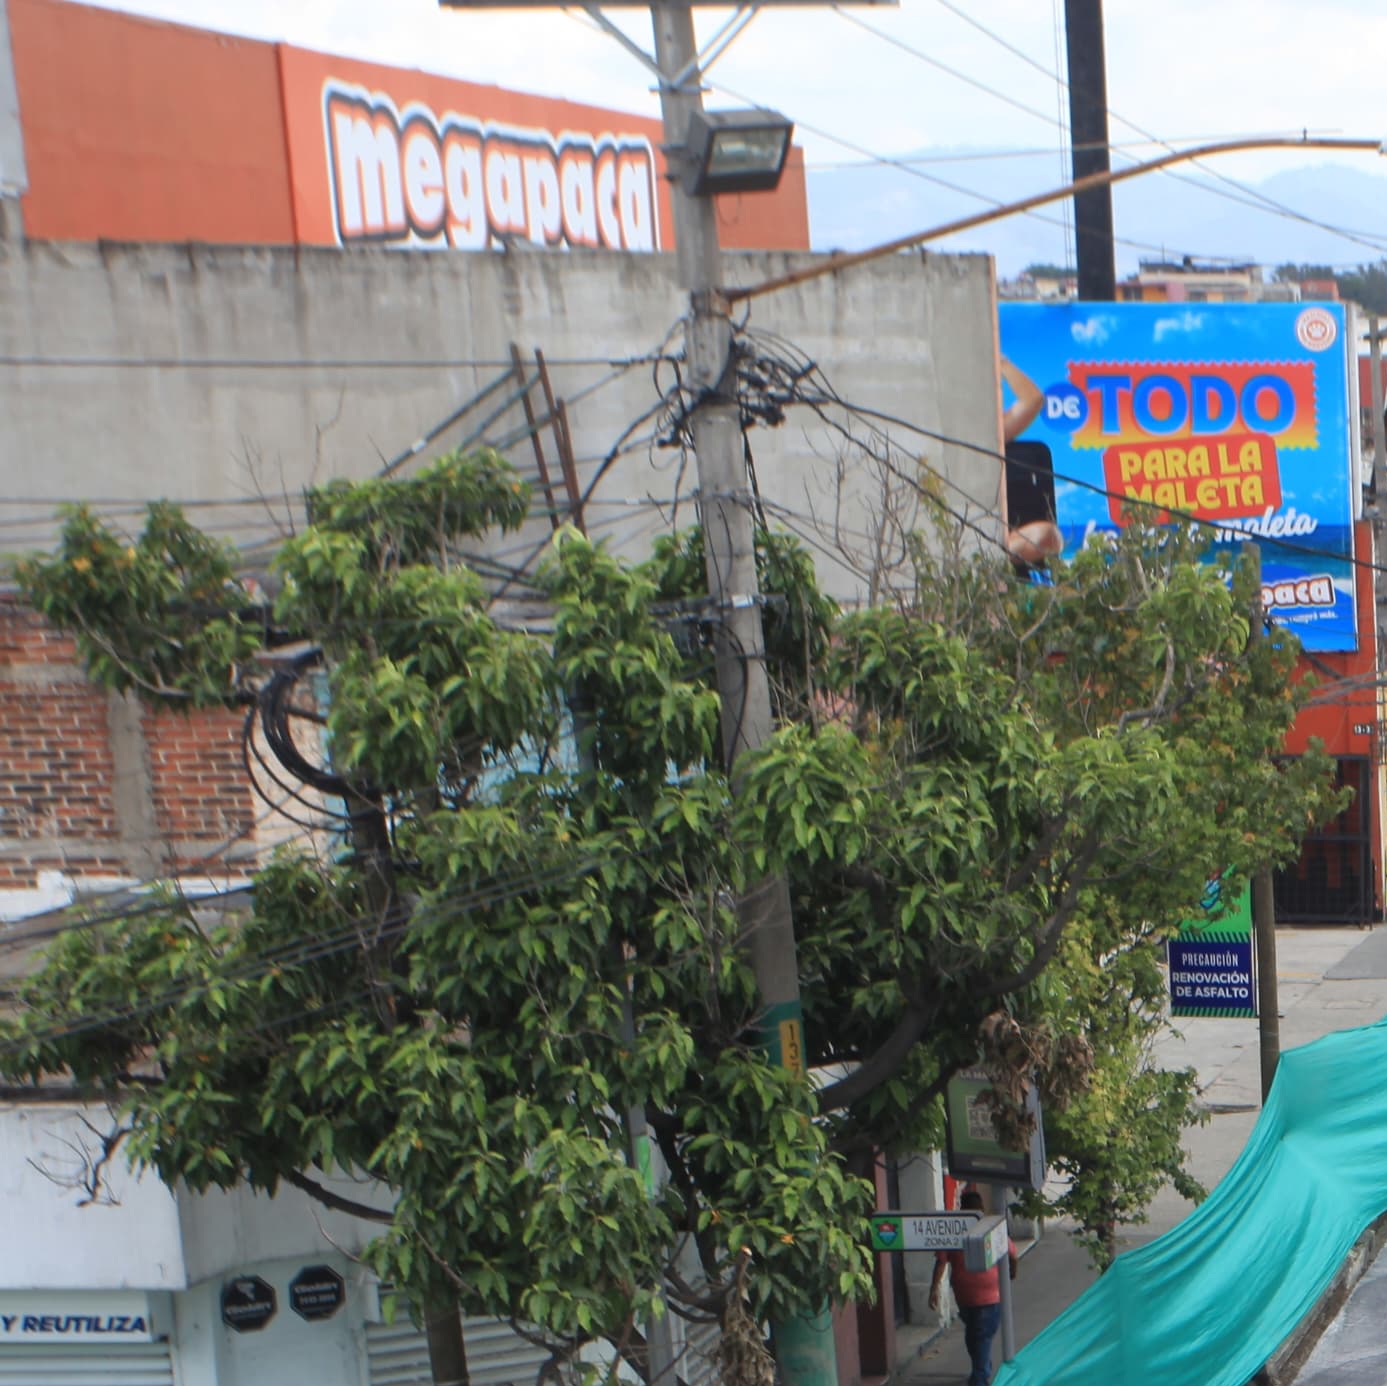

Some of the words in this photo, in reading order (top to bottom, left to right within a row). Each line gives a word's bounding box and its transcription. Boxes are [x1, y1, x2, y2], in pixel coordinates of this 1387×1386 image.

[332, 108, 652, 251] megapaca
[1047, 395, 1081, 419] DE
[1086, 373, 1297, 437] TODO
[1119, 445, 1211, 482] PARA
[1217, 440, 1262, 473] LA
[1124, 475, 1264, 513] MALETA
[1181, 951, 1239, 967] PRECAUCIÓN
[1172, 971, 1249, 985] RENOVACIÓN
[1176, 986, 1192, 997] DE
[1195, 986, 1249, 998] ASFALTO
[912, 1221, 924, 1235] 14
[926, 1219, 969, 1237] AVENIDA
[924, 1237, 951, 1247] ZONA
[1, 1316, 18, 1332] Y
[21, 1315, 147, 1333] REUTILIZA
